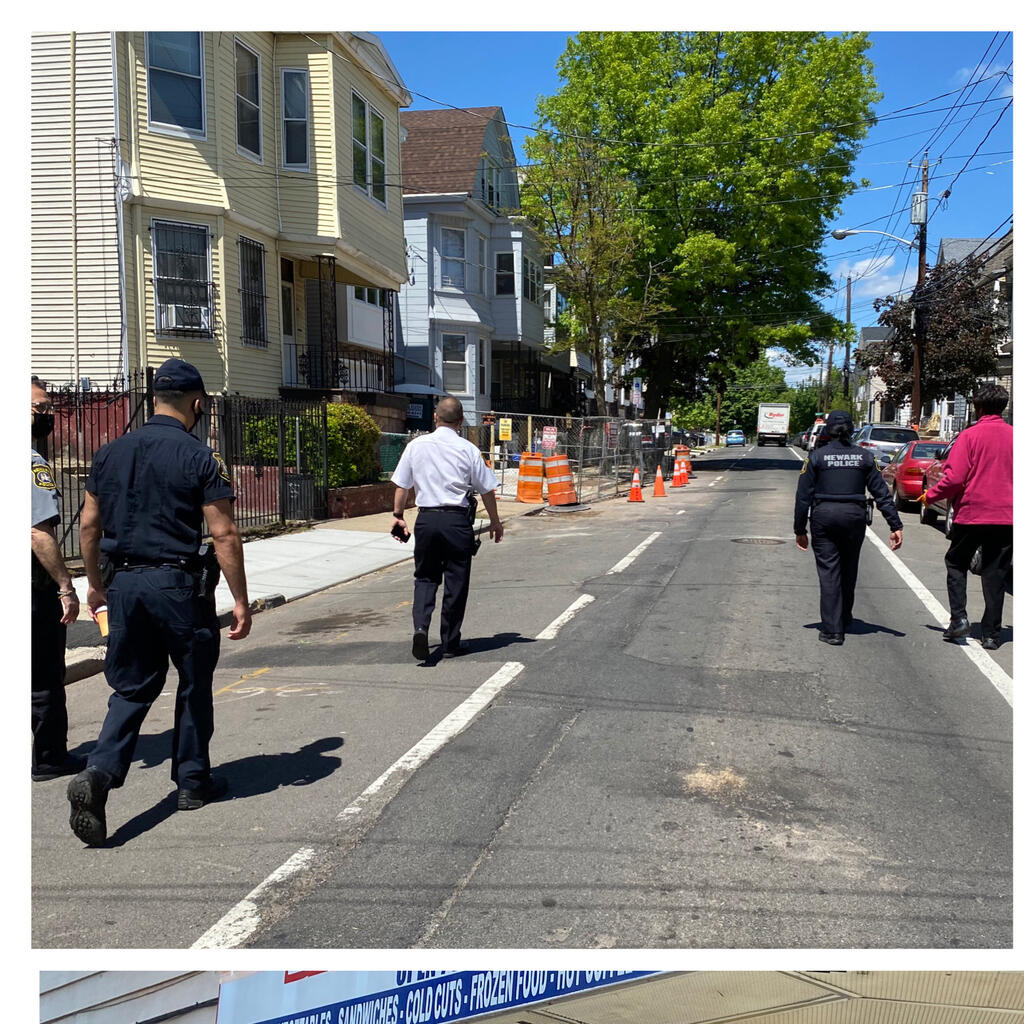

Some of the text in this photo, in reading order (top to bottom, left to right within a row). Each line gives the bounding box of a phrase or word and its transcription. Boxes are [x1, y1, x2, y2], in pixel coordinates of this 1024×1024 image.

[433, 978, 463, 1021] CUTS
[469, 972, 513, 1011] FROZEN
[515, 971, 547, 1000] FOOD
